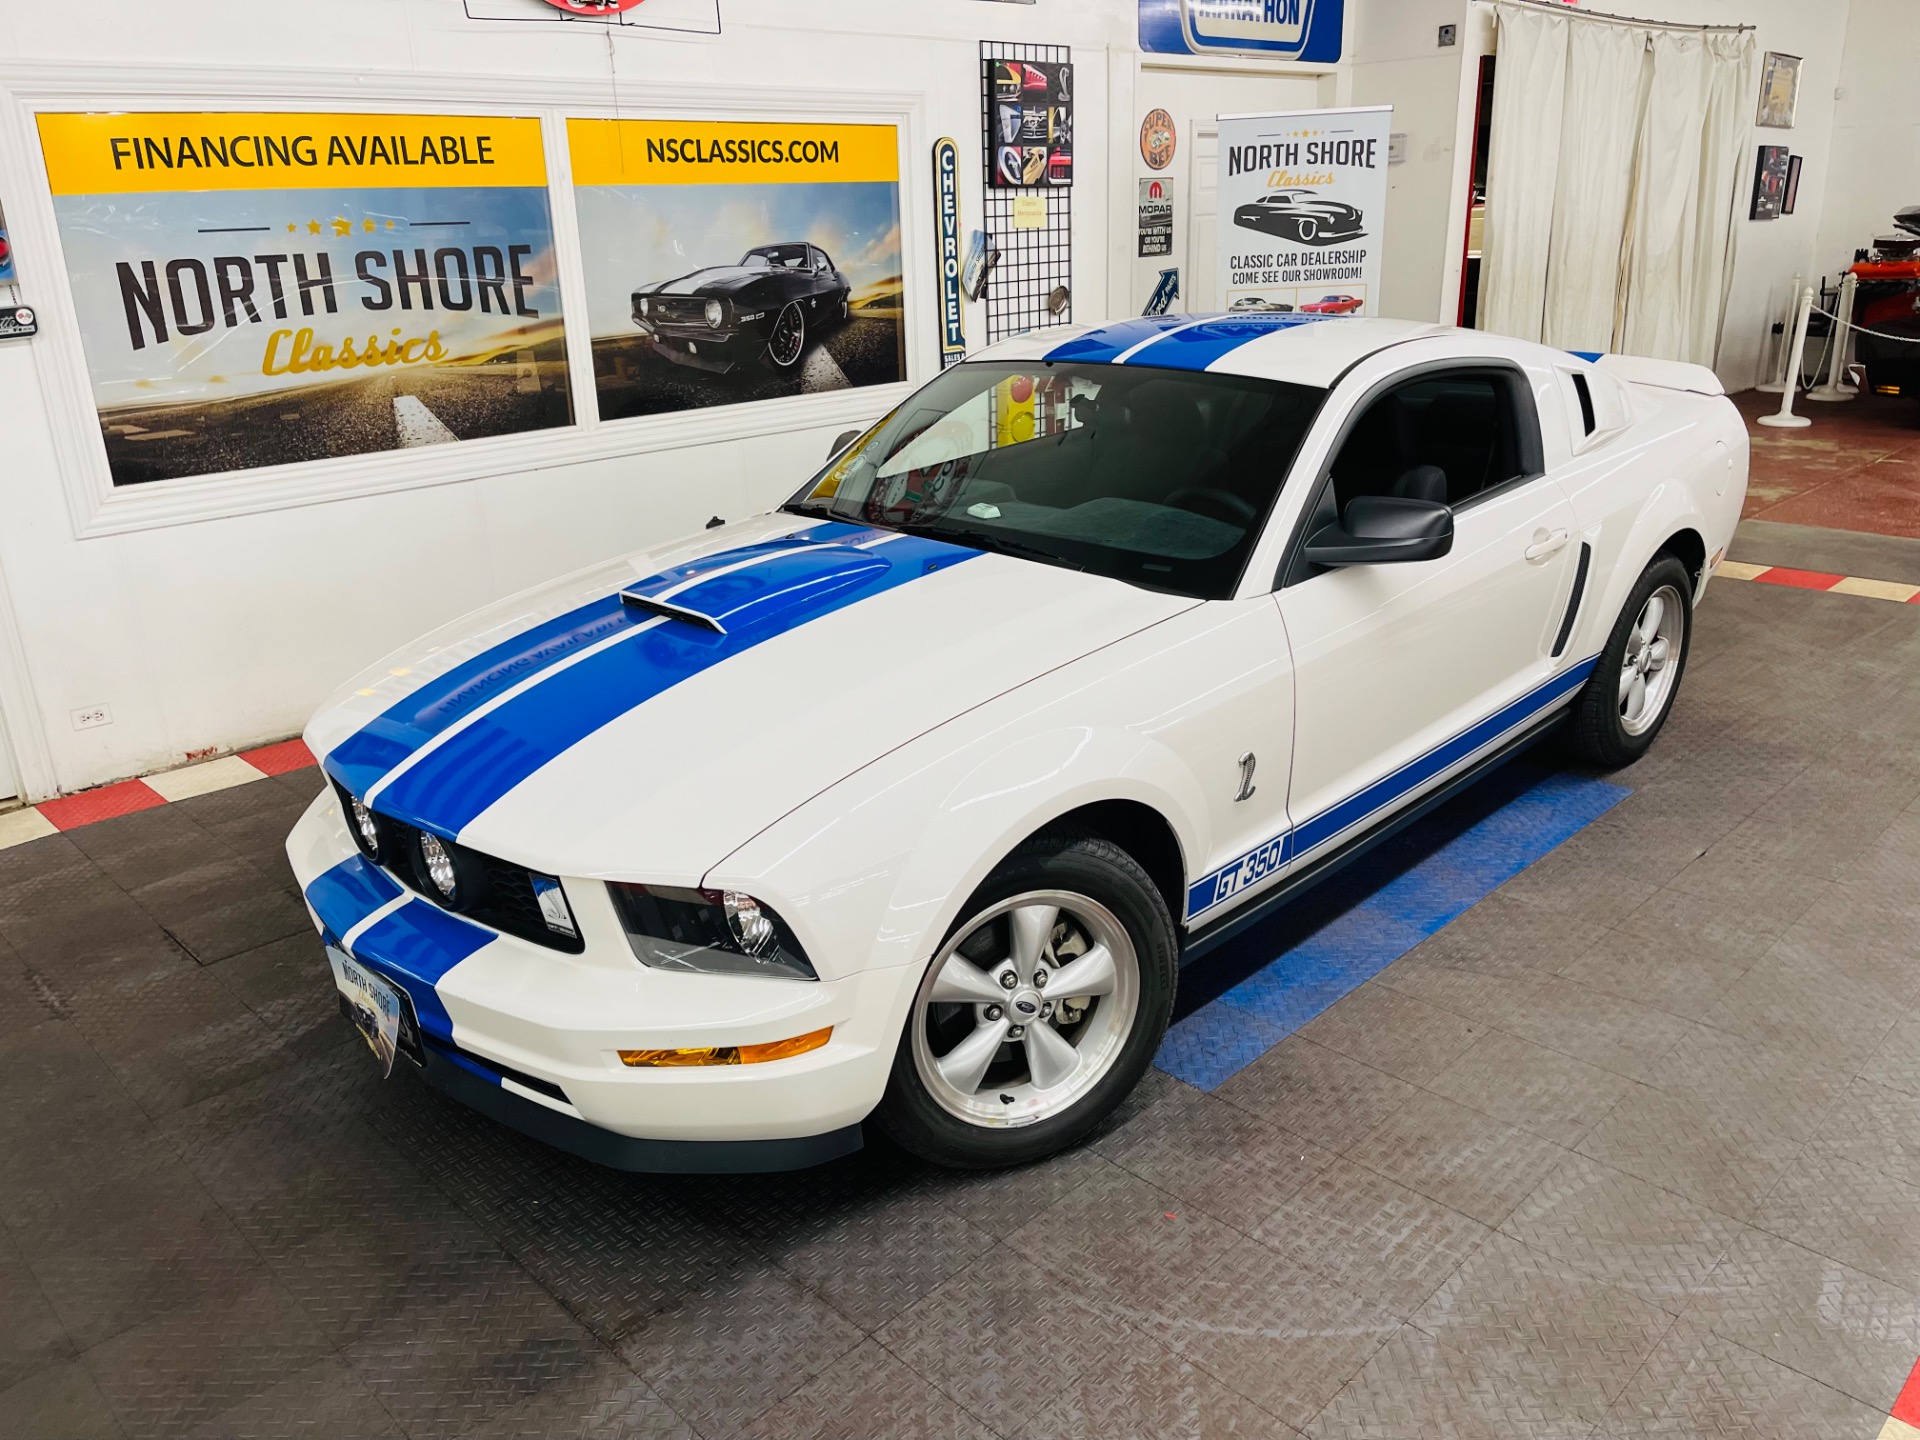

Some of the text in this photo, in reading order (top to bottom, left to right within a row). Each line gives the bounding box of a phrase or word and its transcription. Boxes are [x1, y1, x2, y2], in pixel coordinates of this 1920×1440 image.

[1143, 112, 1173, 133] SUPER
[110, 136, 496, 171] FINANCING AVAILABLE
[646, 138, 839, 164] NSCLASSICS.COM
[1149, 144, 1171, 167] BEE
[1229, 138, 1377, 176] NORTH SHORE
[1267, 170, 1335, 188] Classics
[1139, 204, 1172, 214] MOPAR
[941, 150, 959, 342] CHEVROLET
[1230, 249, 1367, 269] CLASSIC CAR DEALERSHIP
[1232, 266, 1362, 285] COME SEE OUR SHOWROOM!
[115, 244, 540, 350] NORTH SHORE
[262, 327, 448, 377] Classics
[1216, 840, 1281, 901] GT 350
